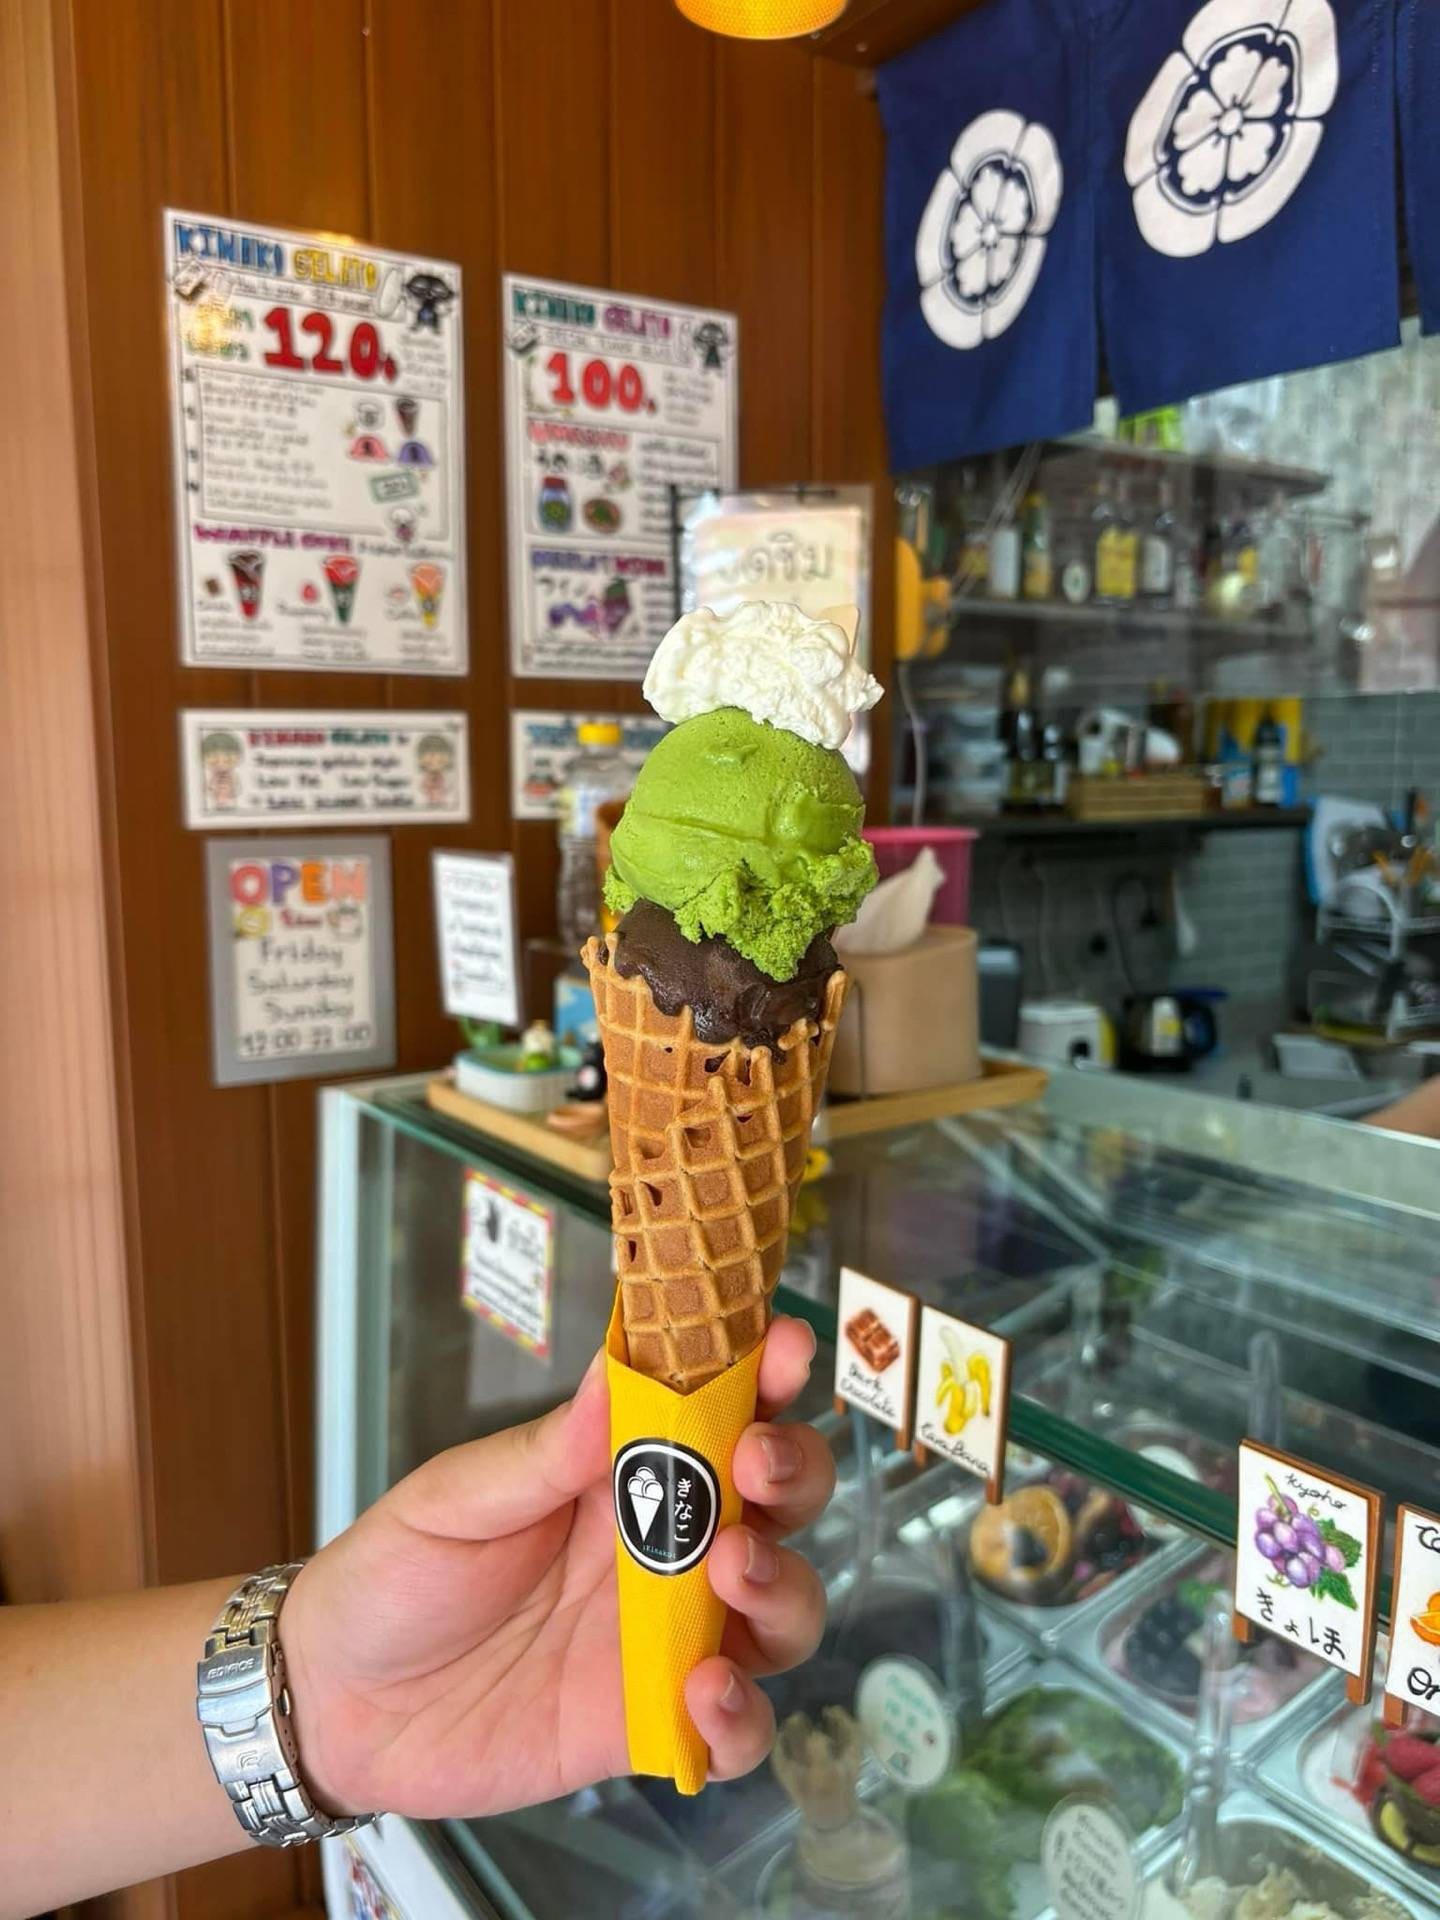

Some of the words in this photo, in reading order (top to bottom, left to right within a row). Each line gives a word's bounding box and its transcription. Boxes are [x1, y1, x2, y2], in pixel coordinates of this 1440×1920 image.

[230, 860, 366, 906] OPEN
[674, 1477, 693, 1542] きなこ
